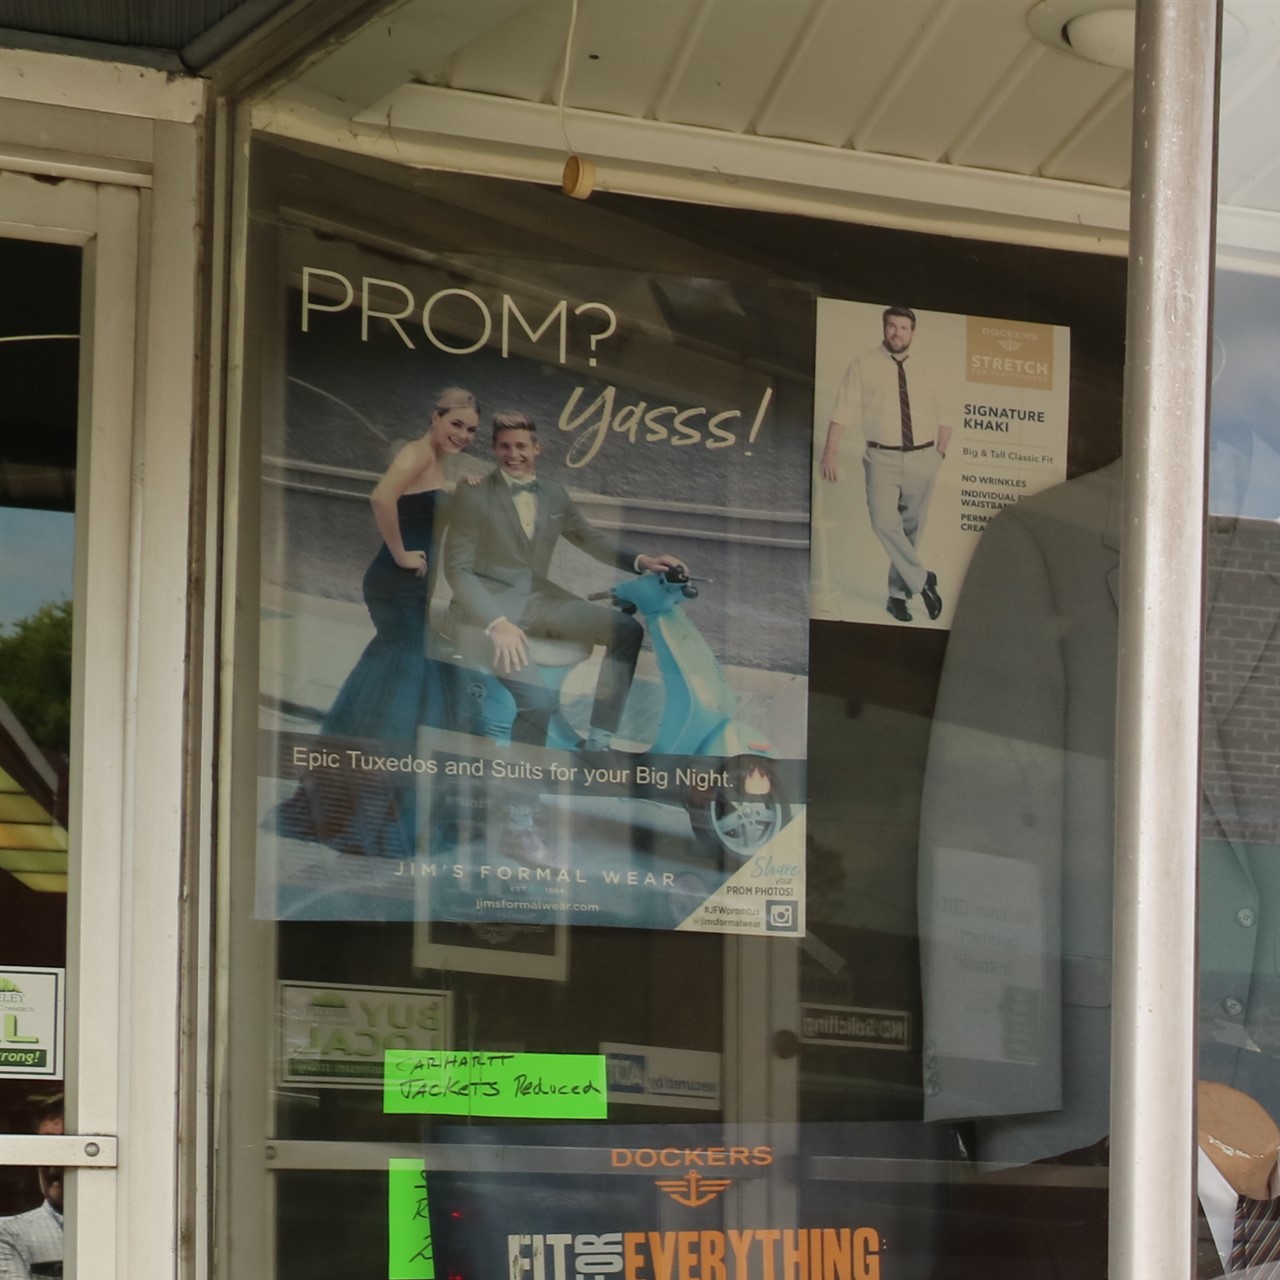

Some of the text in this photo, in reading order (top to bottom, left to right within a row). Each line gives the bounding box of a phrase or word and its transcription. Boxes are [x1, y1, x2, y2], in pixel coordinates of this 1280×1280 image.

[300, 266, 617, 367] PROM?
[971, 354, 1049, 375] STRETCH
[963, 403, 1045, 423] SIGNATURE
[963, 417, 1009, 433] KHAKI
[962, 447, 1053, 464] Big & Tall Classic Fit
[961, 474, 1027, 488] NO WRINKLES
[961, 489, 1016, 502] INDIVIDUAL
[293, 747, 734, 791] Epic Tuxedos and Suits for your Big Night.
[394, 863, 676, 886] JIM'S FORMAL WEAR
[750, 855, 801, 878] Share
[726, 886, 794, 896] PROM PHOTOS!
[775, 878, 793, 886] your
[475, 898, 599, 911] jimsformalwear.com
[0, 1051, 40, 1065] rong!
[396, 1055, 514, 1075] CARHARTT
[610, 1146, 774, 1168] DOCKERS
